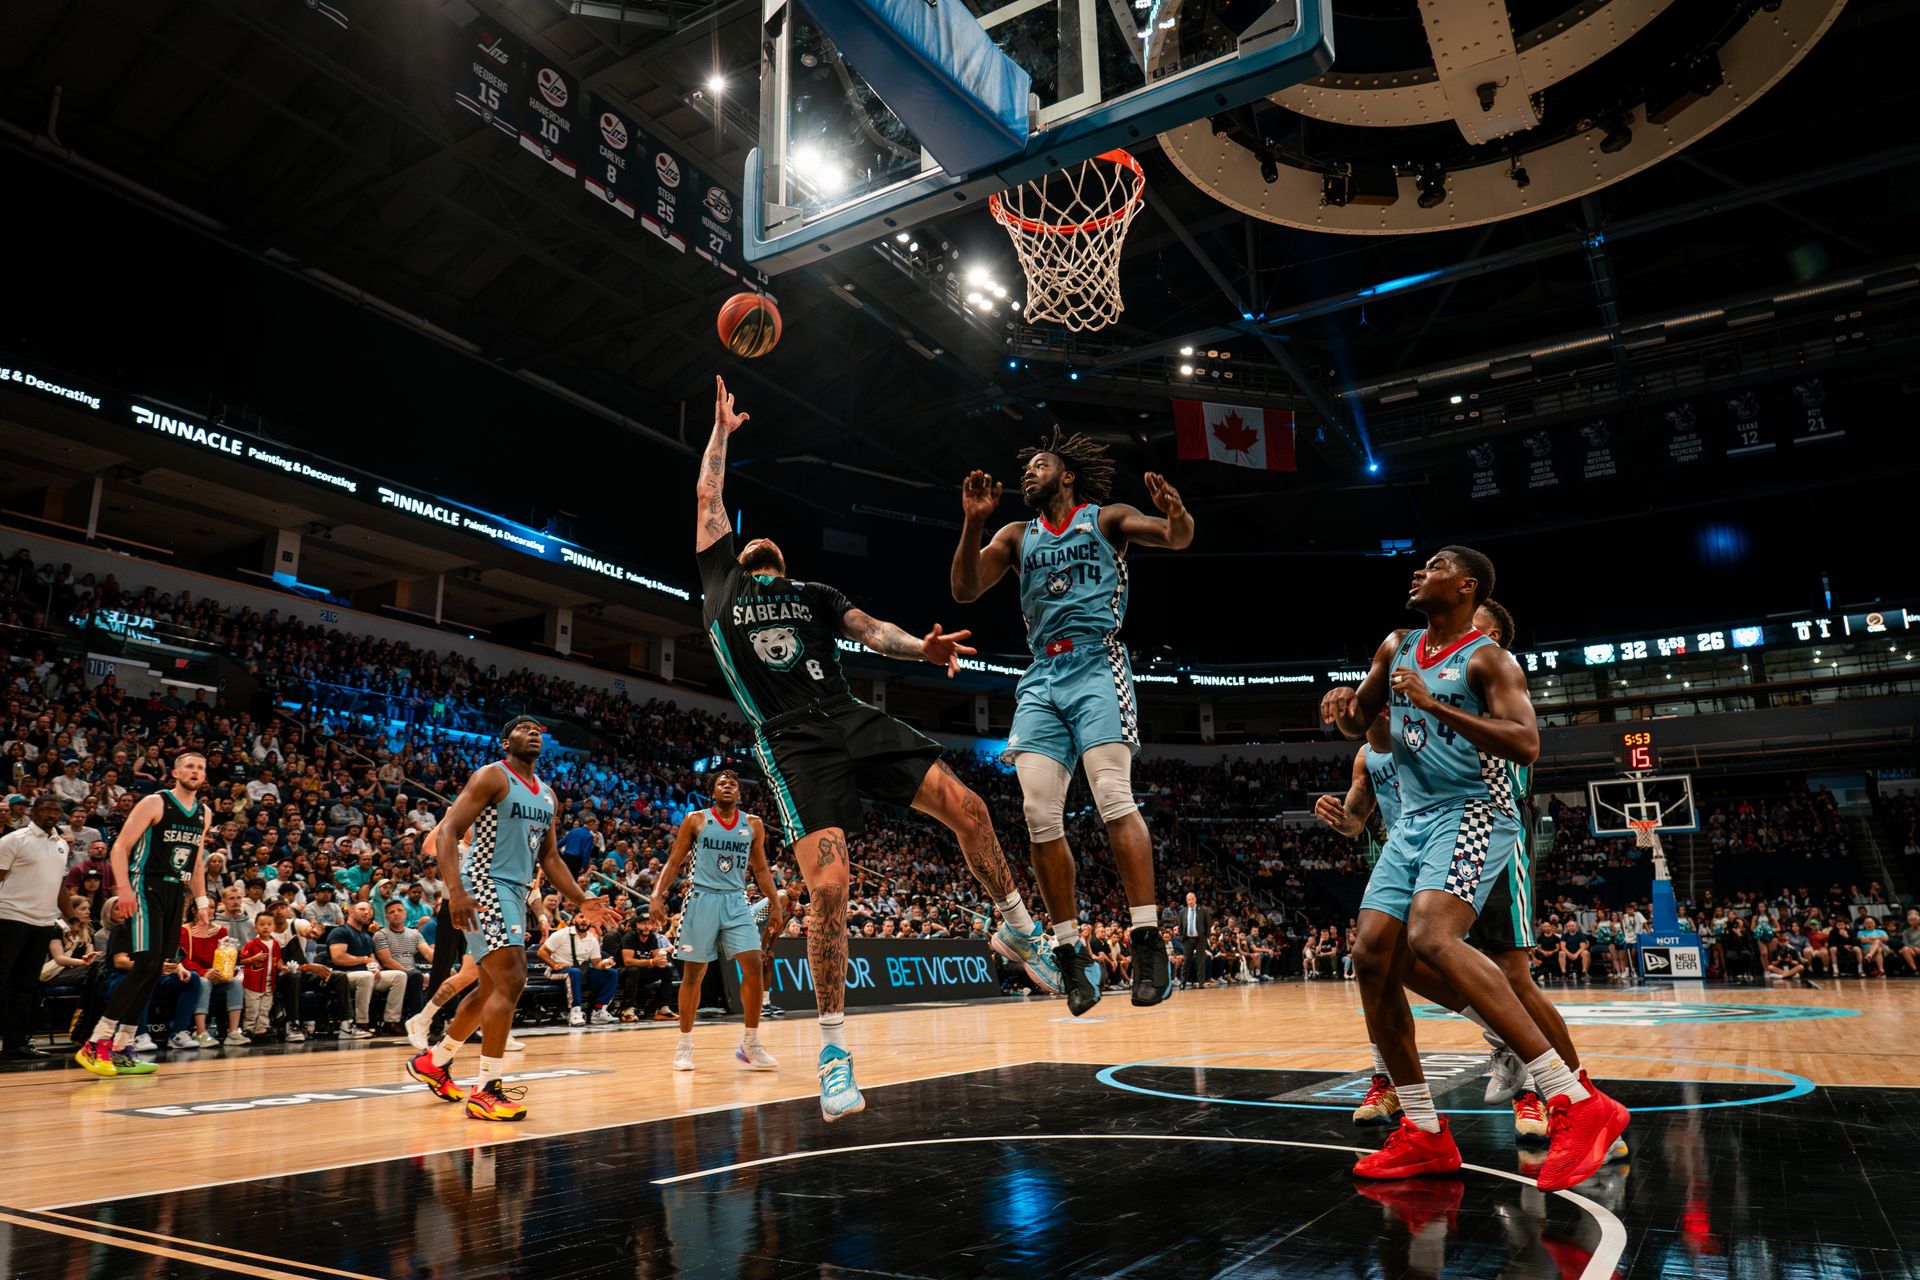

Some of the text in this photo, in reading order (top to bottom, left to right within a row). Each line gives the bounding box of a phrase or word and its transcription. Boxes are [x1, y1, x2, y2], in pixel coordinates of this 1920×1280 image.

[473, 62, 509, 94] HEDBERG
[478, 82, 500, 111] 15
[529, 97, 570, 133] HAWERCHUK
[540, 118, 560, 144] 10
[599, 144, 627, 170] CARLYLE
[606, 166, 617, 184] 8
[657, 186, 676, 206] STEEN
[657, 200, 675, 224] 25
[709, 233, 724, 254] 27
[11, 370, 23, 383] &
[25, 374, 101, 410] Decorating
[1807, 417, 1827, 432] 21
[1741, 431, 1760, 445] 12
[131, 405, 357, 493] PINNACLE Painting & Decorating
[378, 487, 545, 553] PINNACLE Painting & Decorating
[1024, 541, 1101, 574] ALLIANCE
[561, 548, 624, 579] PINNACLE
[626, 572, 652, 588] Painting
[657, 581, 690, 600] Decorating
[1077, 565, 1102, 585] 14
[319, 609, 339, 623] 219
[1798, 623, 1830, 640] 0 1
[1620, 641, 1648, 660] 32
[1657, 636, 1686, 649] 5:53
[1697, 631, 1725, 652] 26
[87, 659, 116, 676] 118
[987, 664, 1009, 674] Painting
[1527, 656, 1556, 671] 2 4
[1146, 674, 1178, 684] Decorating
[1190, 674, 1245, 686] PINNACLE
[1280, 674, 1314, 683] Decorating
[1437, 719, 1457, 745] 4
[1624, 732, 1650, 746] 5:53
[1632, 747, 1650, 768] 15
[736, 855, 746, 869] 13
[179, 870, 192, 881] 30
[1656, 937, 1680, 945] NOTT
[1674, 953, 1697, 962] NEW
[1676, 961, 1697, 970] ERA
[886, 956, 993, 987] BETVICTOR
[134, 1093, 359, 1117] Foot
